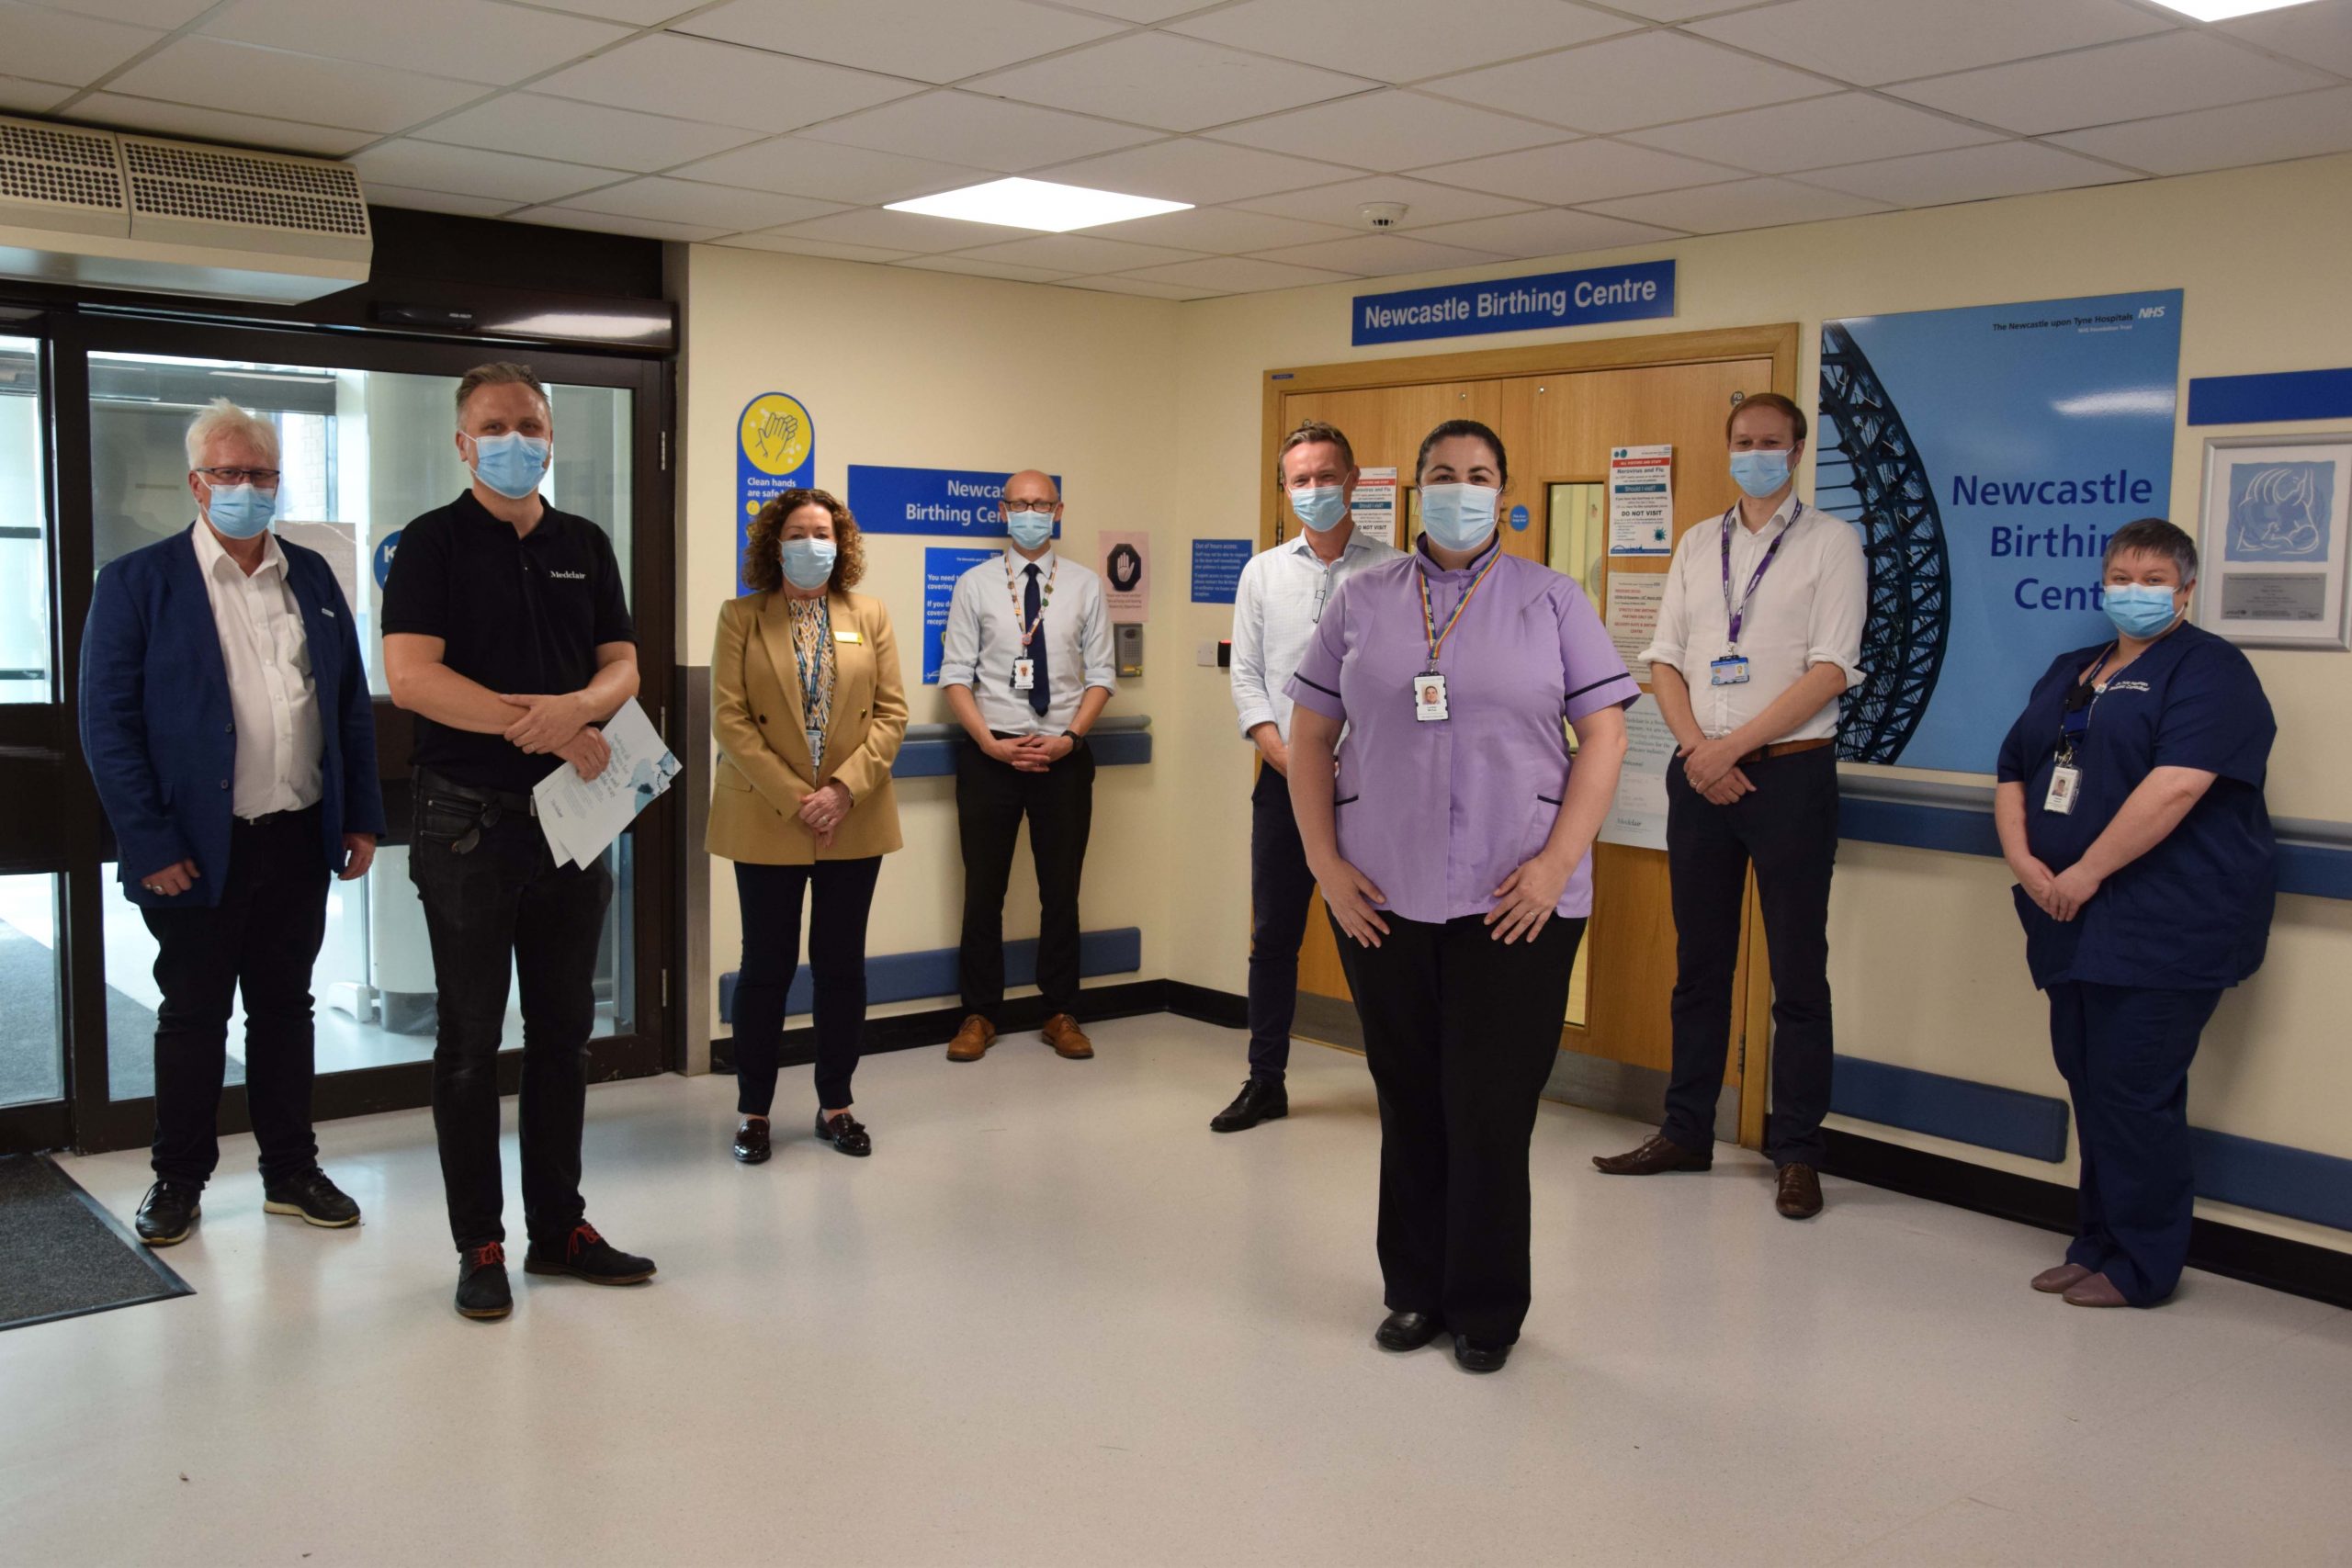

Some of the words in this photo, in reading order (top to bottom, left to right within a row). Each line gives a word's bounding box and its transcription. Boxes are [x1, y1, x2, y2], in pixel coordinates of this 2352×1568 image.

[1365, 297, 1470, 329] Newcastle
[1477, 288, 1566, 317] Birthing
[1575, 278, 1657, 308] Centre
[2139, 306, 2165, 319] NHS
[1993, 323, 2007, 332] The
[2008, 320, 2048, 330] Newcastle
[2052, 320, 2072, 328] upon
[2074, 317, 2093, 326] Tyne
[2095, 313, 2133, 324] Hospitals
[747, 477, 771, 486] Clean
[772, 478, 797, 487] hands
[1952, 469, 2153, 506] Newcastle
[763, 489, 779, 497] safe
[906, 503, 971, 526] Birthing
[550, 570, 586, 579] Medclair
[927, 583, 953, 592] covering
[2015, 578, 2105, 612] Cent
